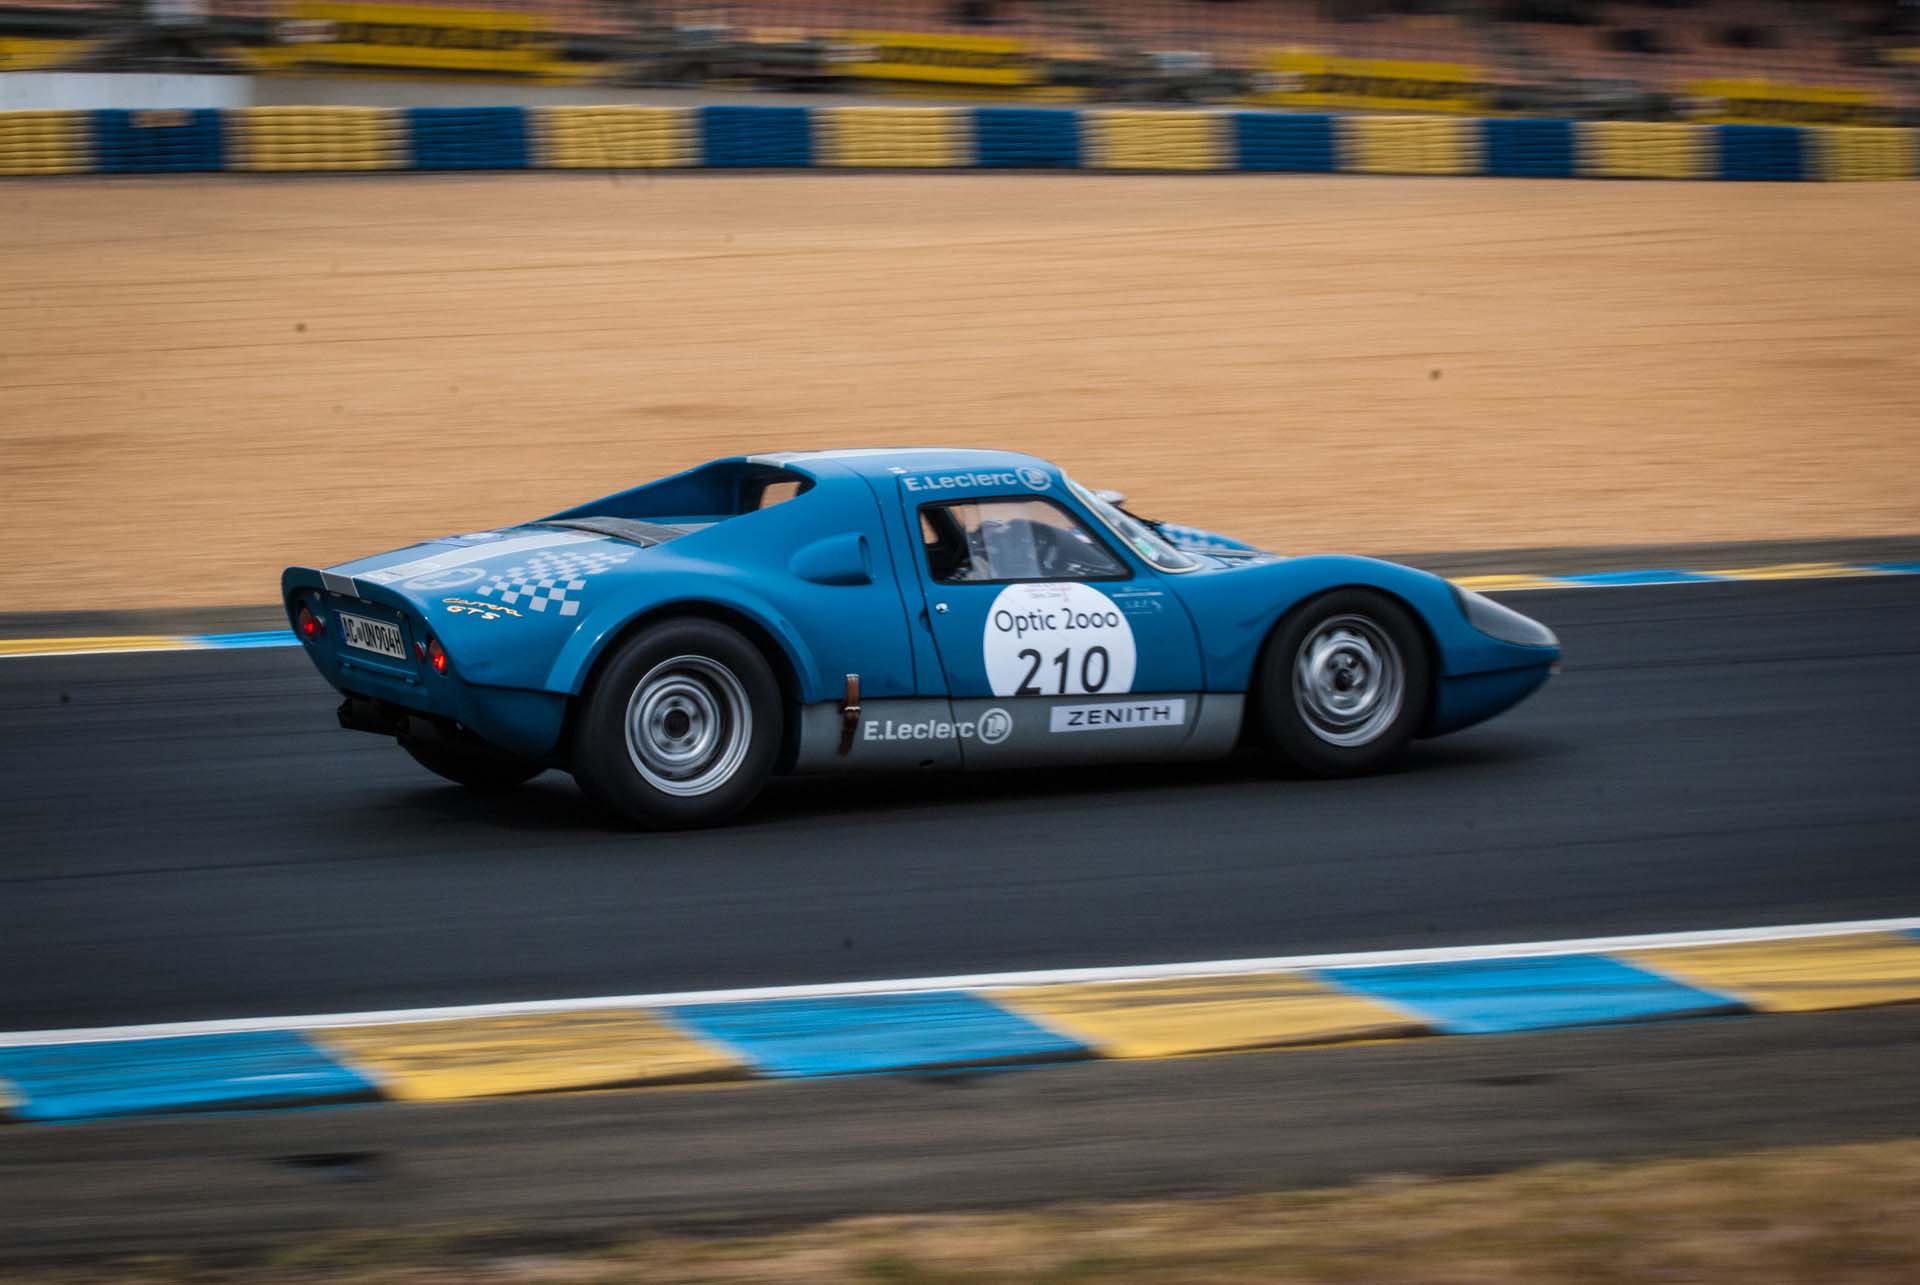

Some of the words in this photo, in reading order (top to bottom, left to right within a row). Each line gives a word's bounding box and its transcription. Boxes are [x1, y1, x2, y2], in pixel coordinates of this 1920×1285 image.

[903, 471, 1018, 491] E.Leclerc
[442, 598, 523, 617] Carrera
[447, 605, 501, 620] GTS
[994, 609, 1056, 638] Optic
[1015, 646, 1109, 695] 210
[1067, 706, 1171, 726] ZENITH
[863, 720, 975, 740] E.Leclerc
